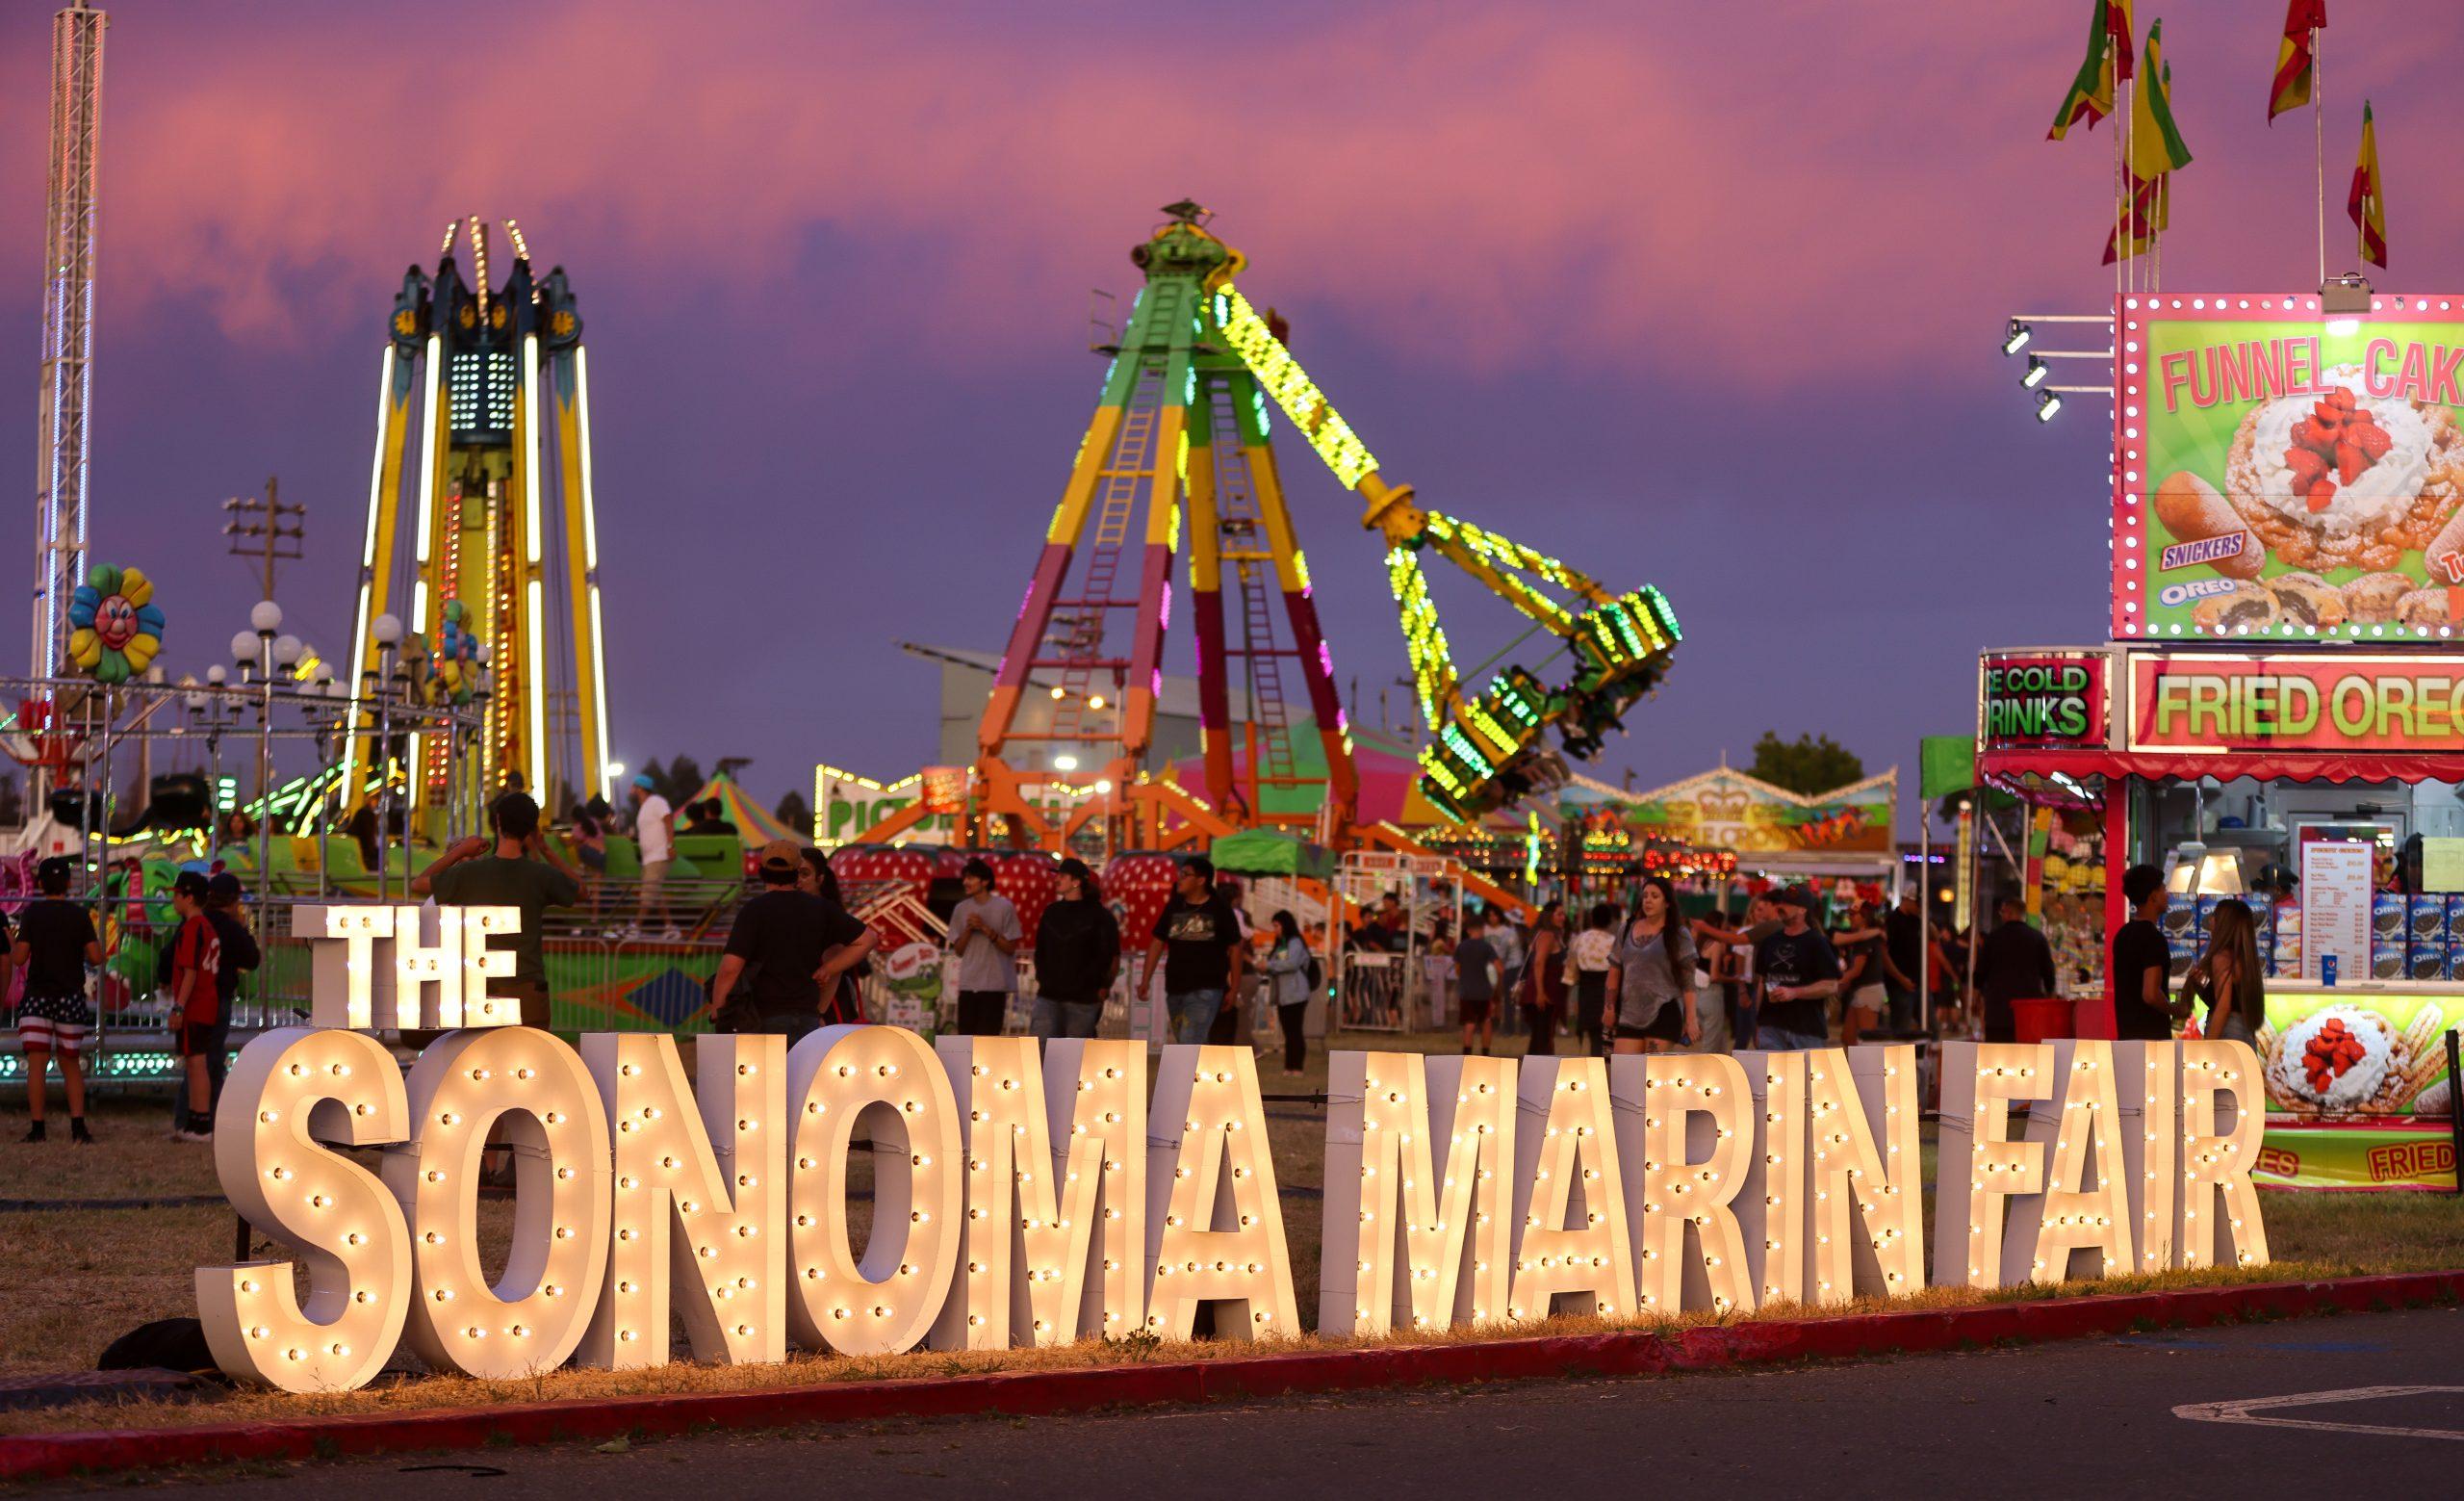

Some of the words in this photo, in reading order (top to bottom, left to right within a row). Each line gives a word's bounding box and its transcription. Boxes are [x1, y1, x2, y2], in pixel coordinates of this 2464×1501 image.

[2159, 335, 2336, 413] FUNNEL
[2364, 337, 2464, 407] CAK
[2164, 532, 2243, 568] SNICKERS
[2159, 578, 2237, 608] OREO
[2006, 666, 2089, 692] COLD
[2156, 675, 2321, 737] FRIED
[292, 904, 523, 1029] THE
[2367, 1140, 2456, 1182] FRIED
[195, 1024, 1301, 1393] SONOMA
[1319, 1043, 1925, 1337] MARIN
[1933, 1038, 2270, 1289] FAIR
